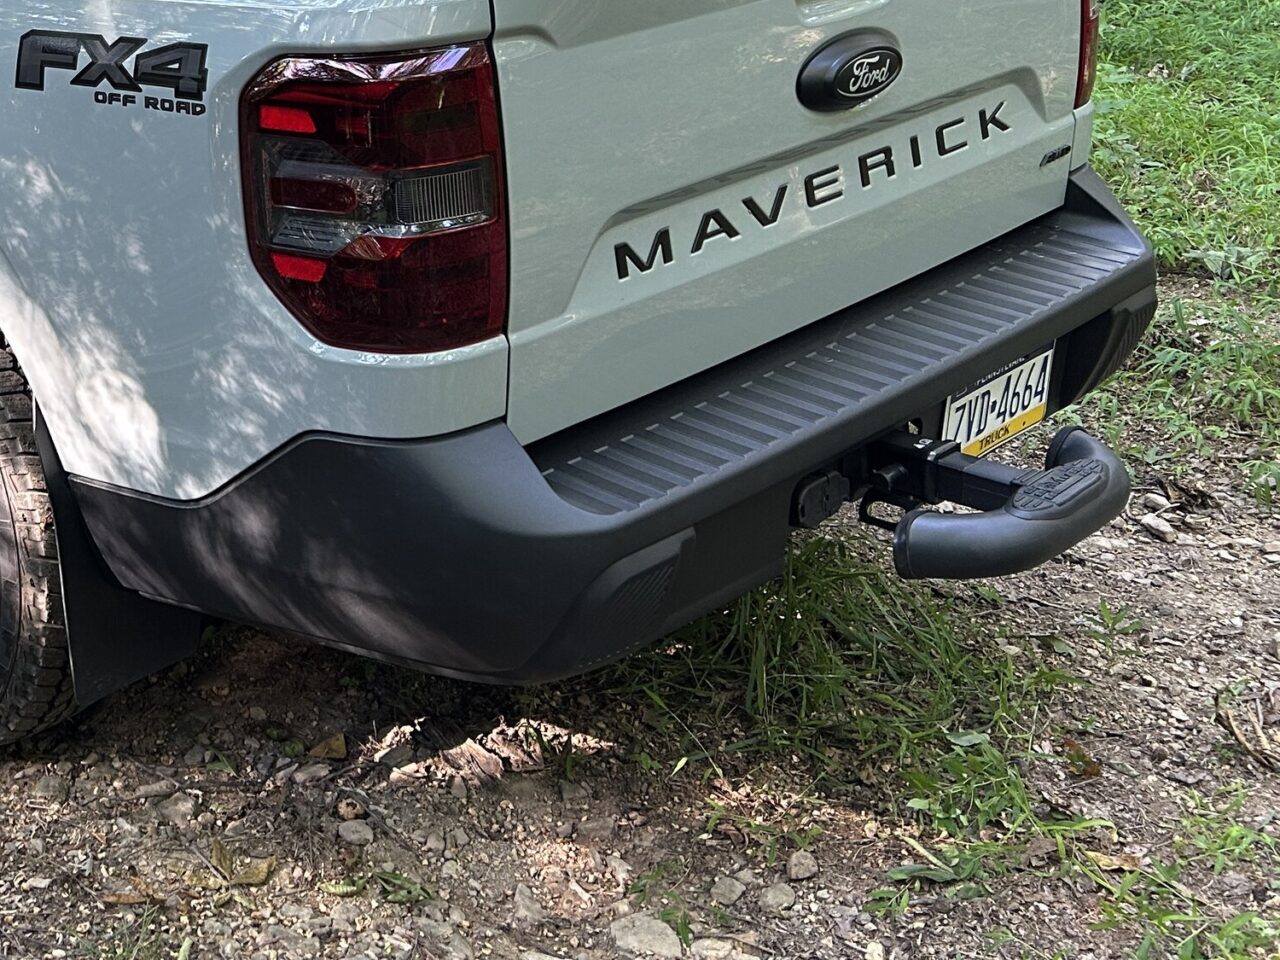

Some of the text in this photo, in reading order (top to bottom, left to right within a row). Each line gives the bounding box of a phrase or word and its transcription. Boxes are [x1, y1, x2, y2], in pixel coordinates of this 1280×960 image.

[14, 28, 209, 102] FX4
[849, 54, 891, 93] Ford
[94, 91, 207, 116] OFF ROAD
[614, 100, 1013, 282] MAVERICK
[979, 424, 1011, 451] TRUCK
